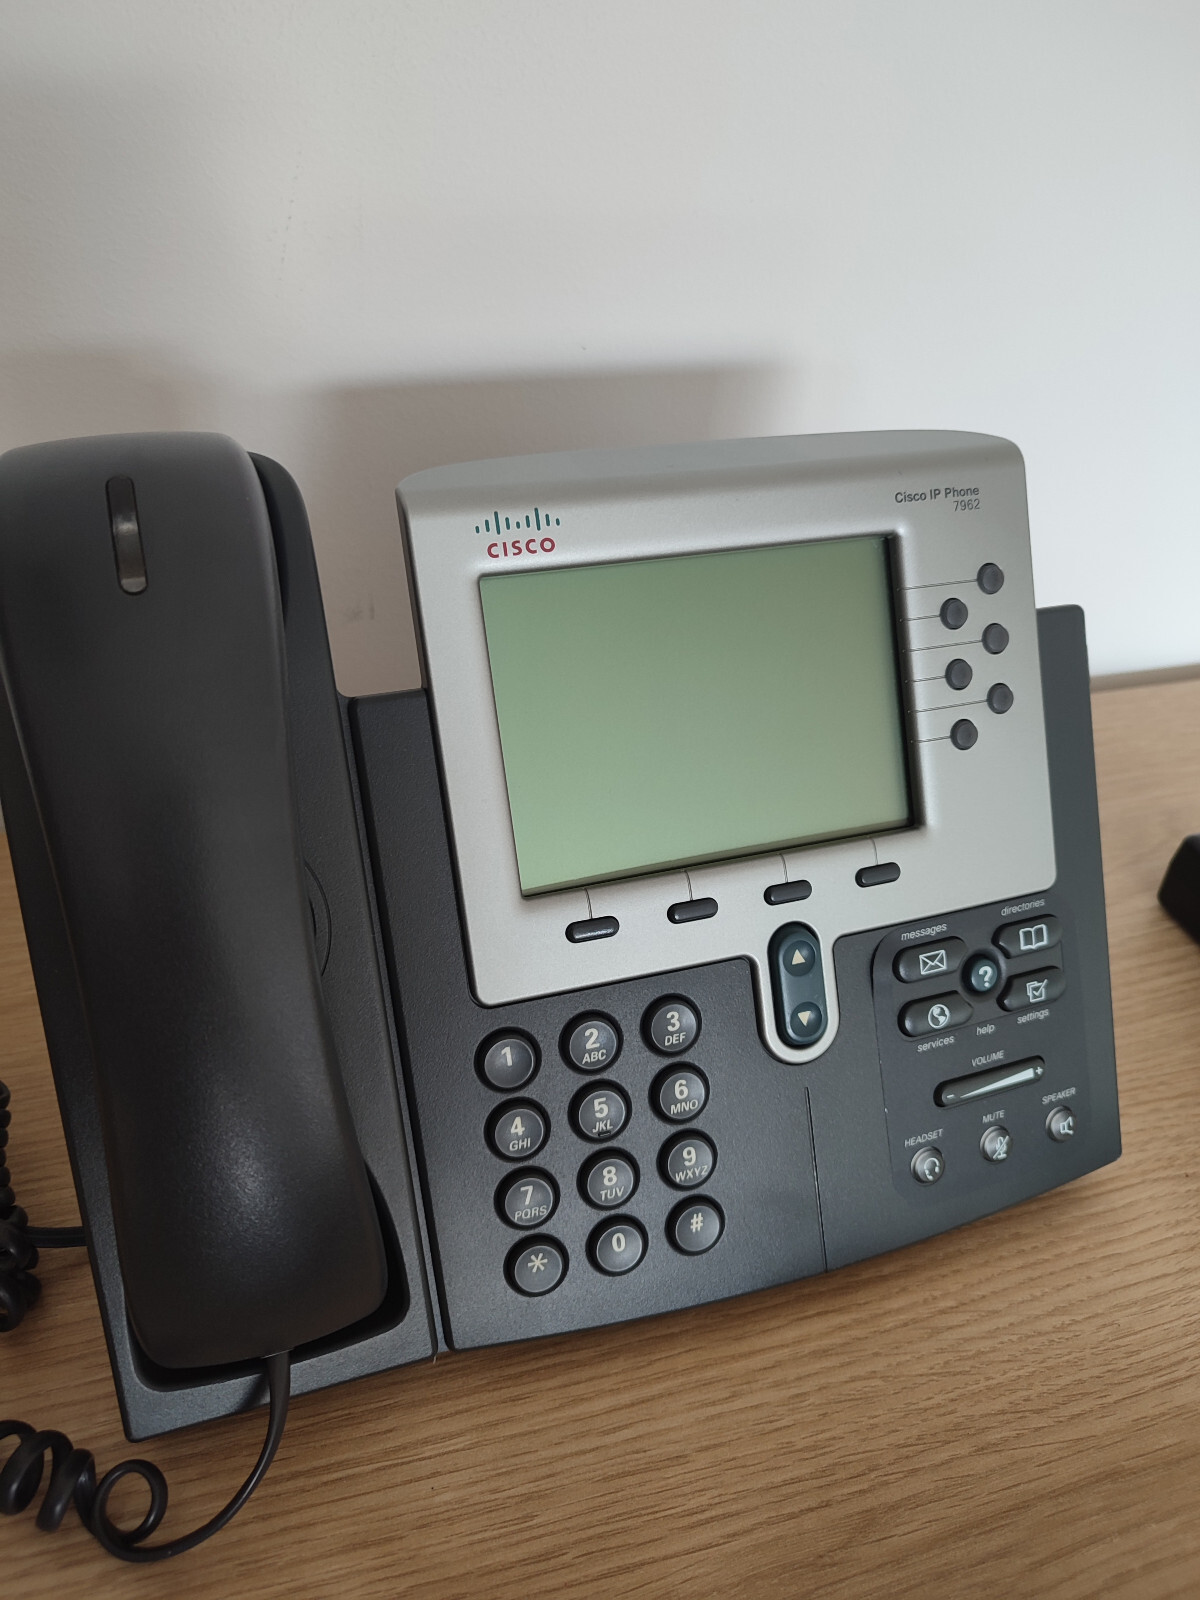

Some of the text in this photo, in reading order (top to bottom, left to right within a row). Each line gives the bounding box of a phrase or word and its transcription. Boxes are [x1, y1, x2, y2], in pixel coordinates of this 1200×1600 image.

[894, 486, 980, 504] Cisco IP Phone
[953, 498, 980, 512] 7962
[487, 537, 556, 559] CISCO
[1001, 899, 1045, 916] directories
[901, 923, 947, 941] messages
[666, 1011, 681, 1032] 3
[1017, 1009, 1049, 1024] settings
[976, 1024, 995, 1036] help
[584, 1028, 600, 1050] 2
[664, 1032, 686, 1046] DEF
[917, 1035, 954, 1052] services
[501, 1047, 513, 1067] 1
[582, 1049, 607, 1064] ABC
[971, 1051, 1004, 1067] VOLUME
[674, 1079, 689, 1100] 6
[1042, 1087, 1076, 1105] SPEAKER
[593, 1097, 609, 1119] 5
[670, 1100, 699, 1114] MNO
[982, 1110, 1005, 1123] MUTE
[510, 1116, 526, 1137] 4
[592, 1120, 613, 1133] JKL
[509, 1138, 531, 1151] GHI
[904, 1129, 943, 1147] HEADSET
[682, 1146, 697, 1167] 9
[602, 1166, 618, 1187] 8
[675, 1166, 708, 1183] WXYZ
[520, 1185, 534, 1206] 7
[600, 1186, 625, 1201] TUV
[514, 1206, 547, 1221] PQRS
[611, 1233, 626, 1252] 0
